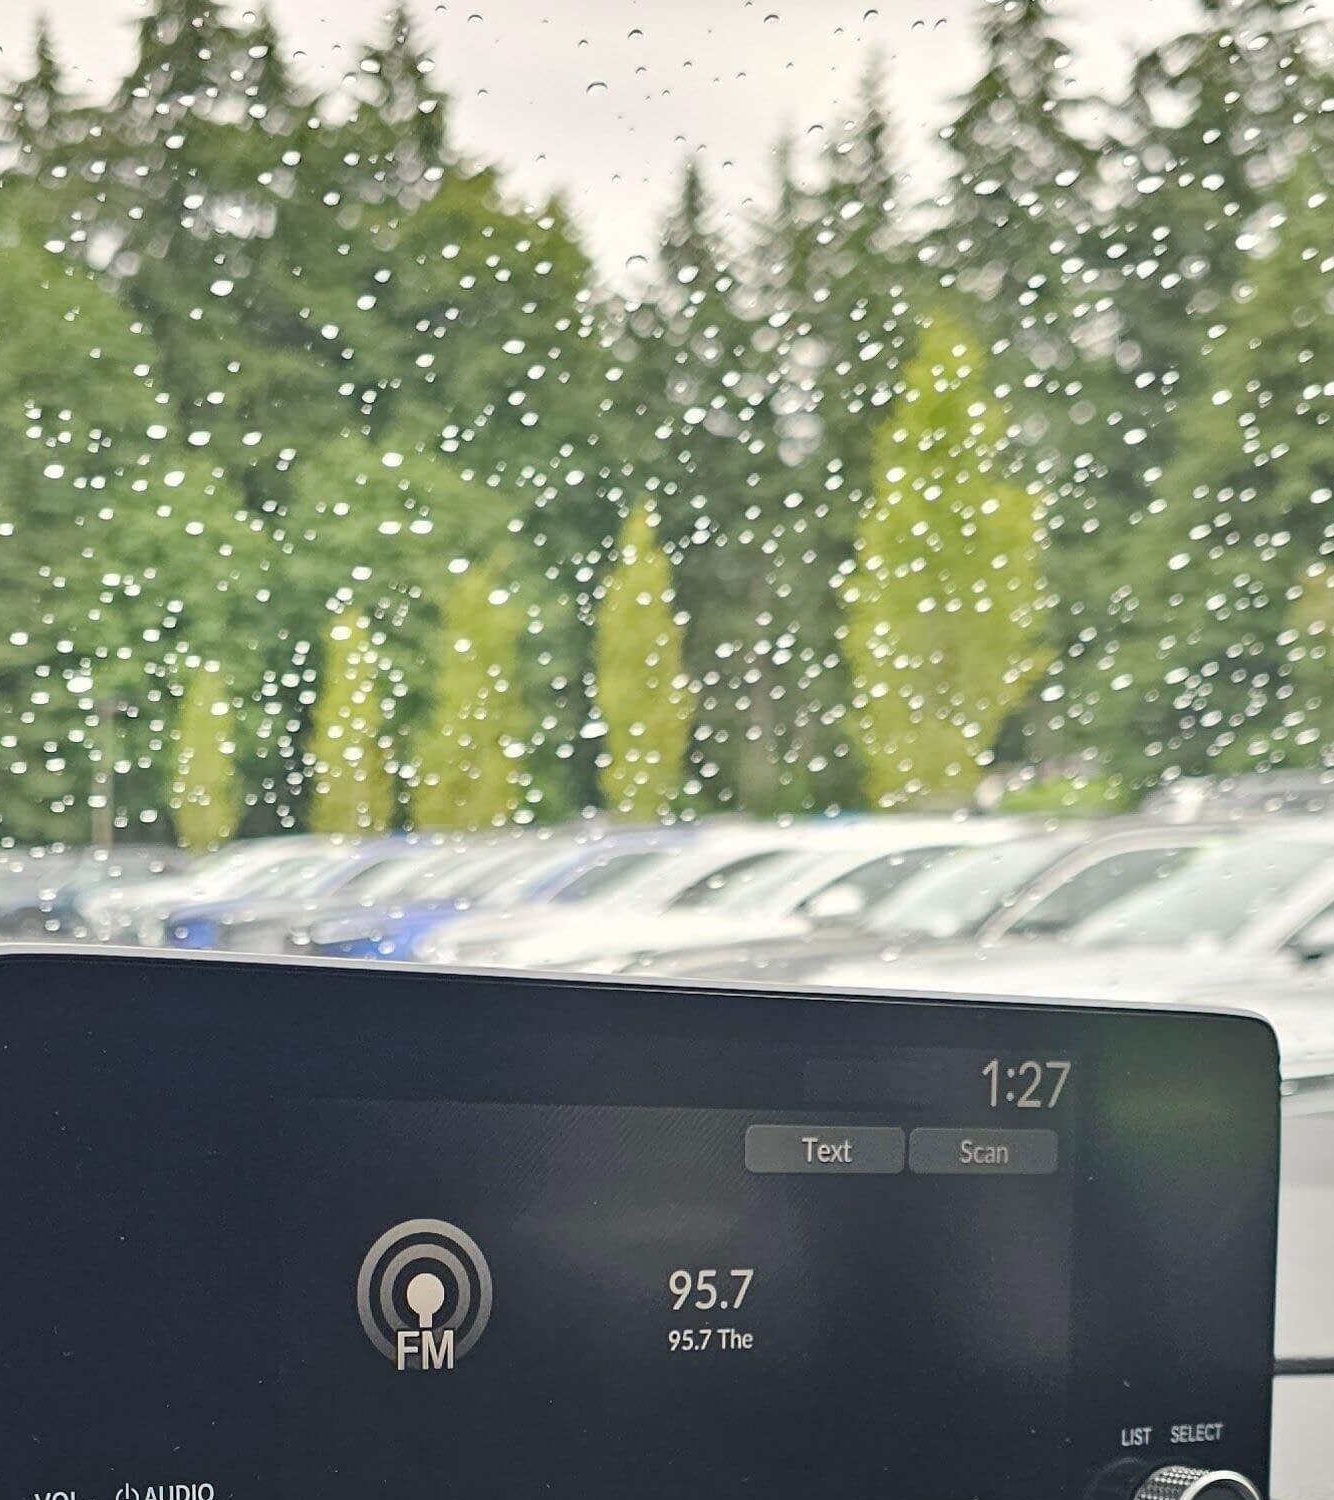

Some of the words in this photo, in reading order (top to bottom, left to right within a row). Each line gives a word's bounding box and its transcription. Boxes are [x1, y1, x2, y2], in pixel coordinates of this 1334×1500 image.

[981, 1057, 1072, 1108] 1:27
[801, 1136, 853, 1164] Text
[959, 1139, 1009, 1165] Scan
[668, 1268, 755, 1311] 95.7
[396, 1329, 455, 1371] FM
[668, 1330, 711, 1352] 95.7
[717, 1329, 754, 1350] The
[1121, 1426, 1153, 1447] LIST
[1170, 1422, 1224, 1444] SELECT
